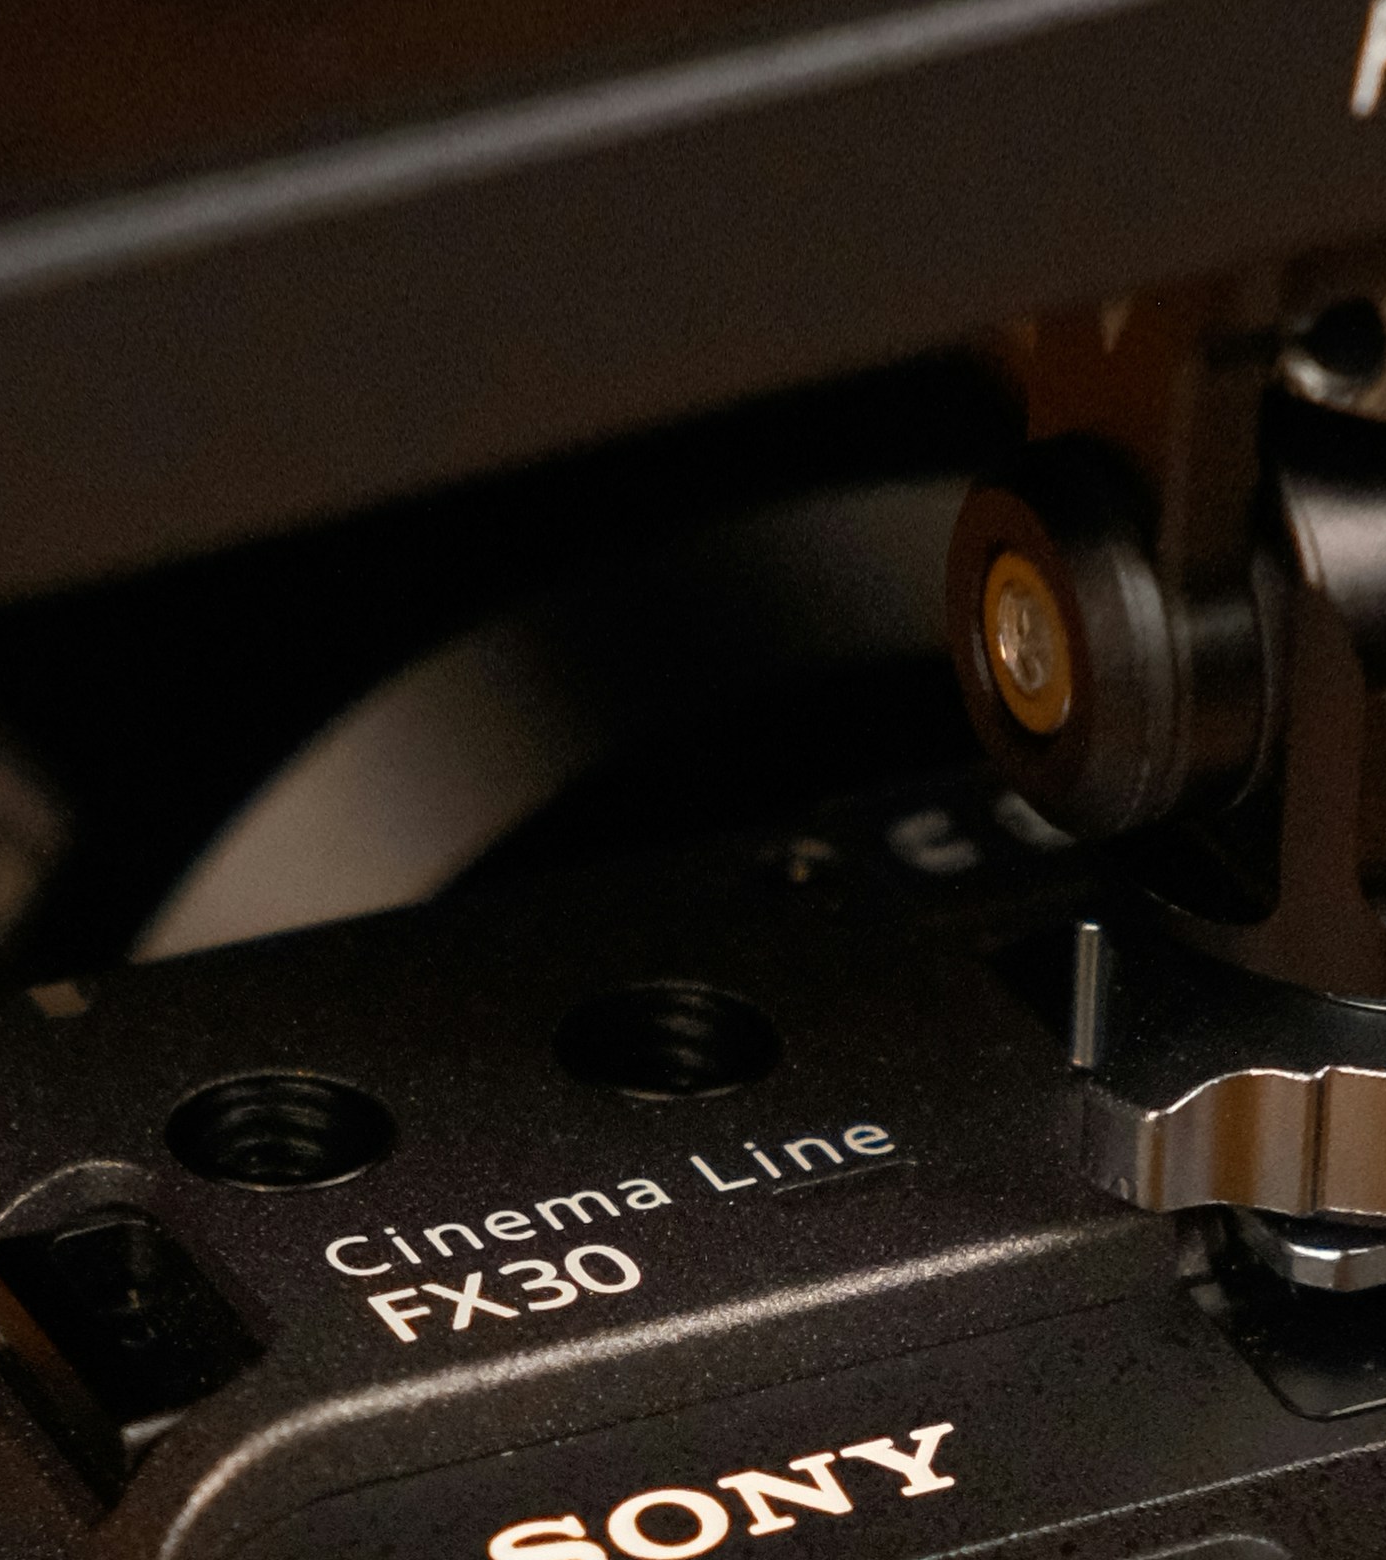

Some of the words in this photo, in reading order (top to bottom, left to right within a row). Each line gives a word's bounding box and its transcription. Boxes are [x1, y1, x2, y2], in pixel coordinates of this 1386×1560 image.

[324, 1176, 672, 1278] Cinema
[691, 1122, 896, 1193] Line
[367, 1243, 642, 1342] FX30
